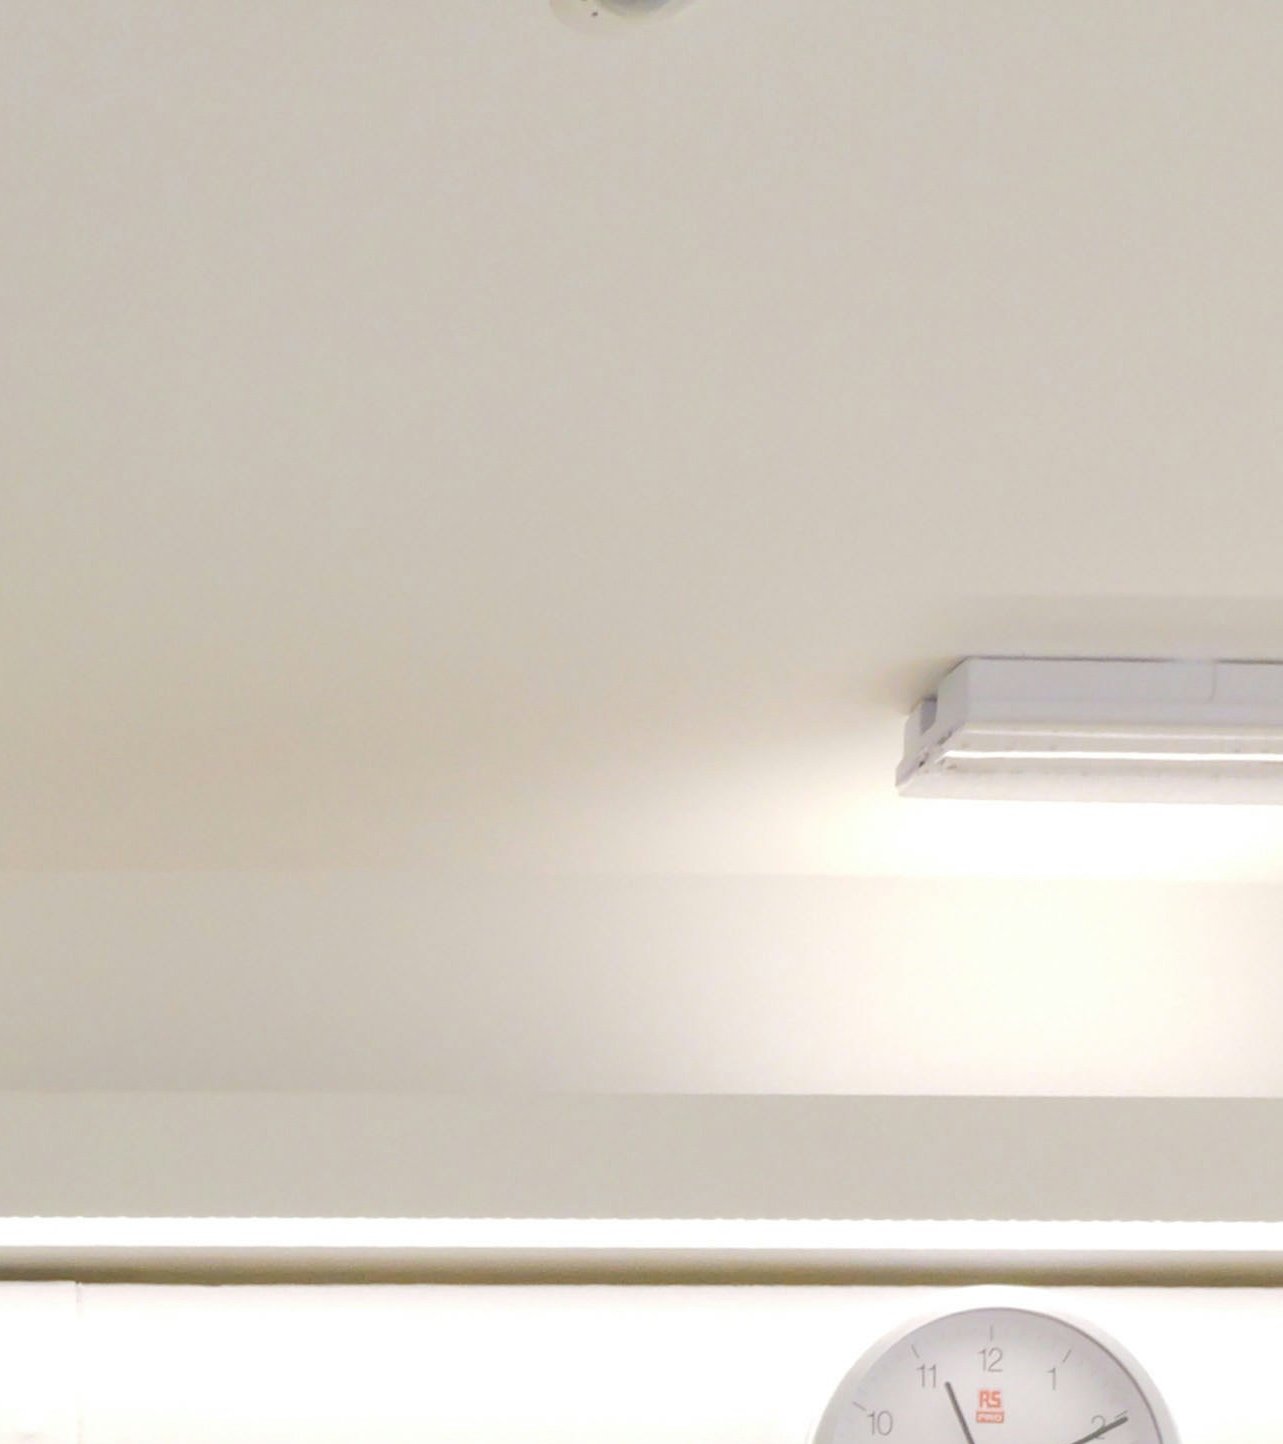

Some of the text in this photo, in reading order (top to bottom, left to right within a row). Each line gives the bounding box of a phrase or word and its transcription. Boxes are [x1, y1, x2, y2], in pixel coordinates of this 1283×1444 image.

[978, 1346, 1004, 1373] 12
[916, 1362, 937, 1388] 11
[1047, 1366, 1057, 1391] 1
[977, 1390, 1002, 1408] RS
[866, 1409, 894, 1436] 10
